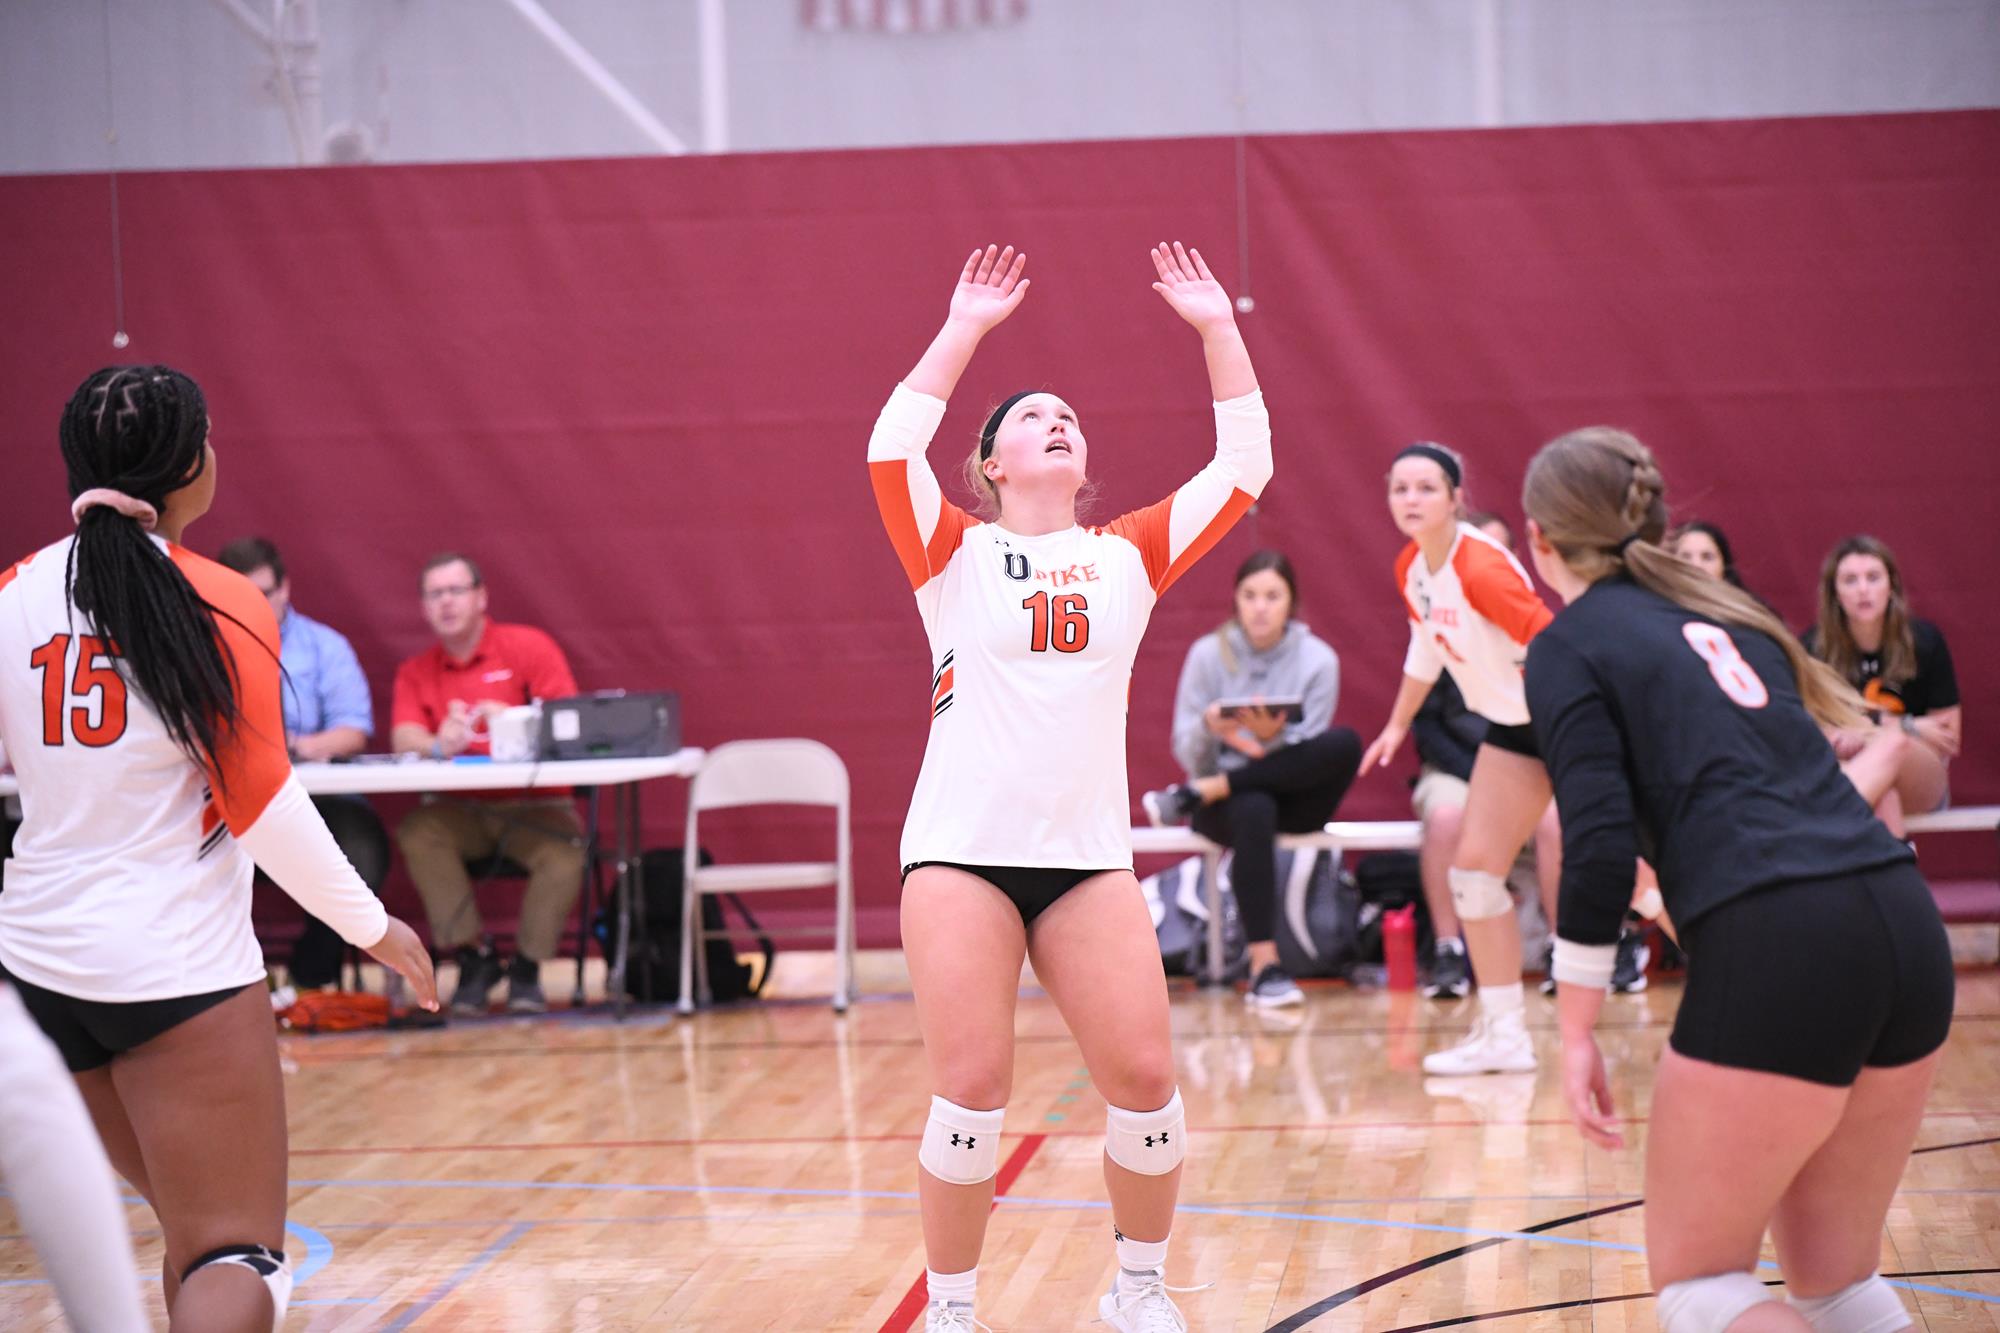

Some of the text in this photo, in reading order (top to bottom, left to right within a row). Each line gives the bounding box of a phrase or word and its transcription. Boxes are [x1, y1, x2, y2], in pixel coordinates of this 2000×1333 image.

[1022, 591, 1090, 653] 16
[1681, 621, 1769, 709] 8
[30, 633, 128, 748] 15
